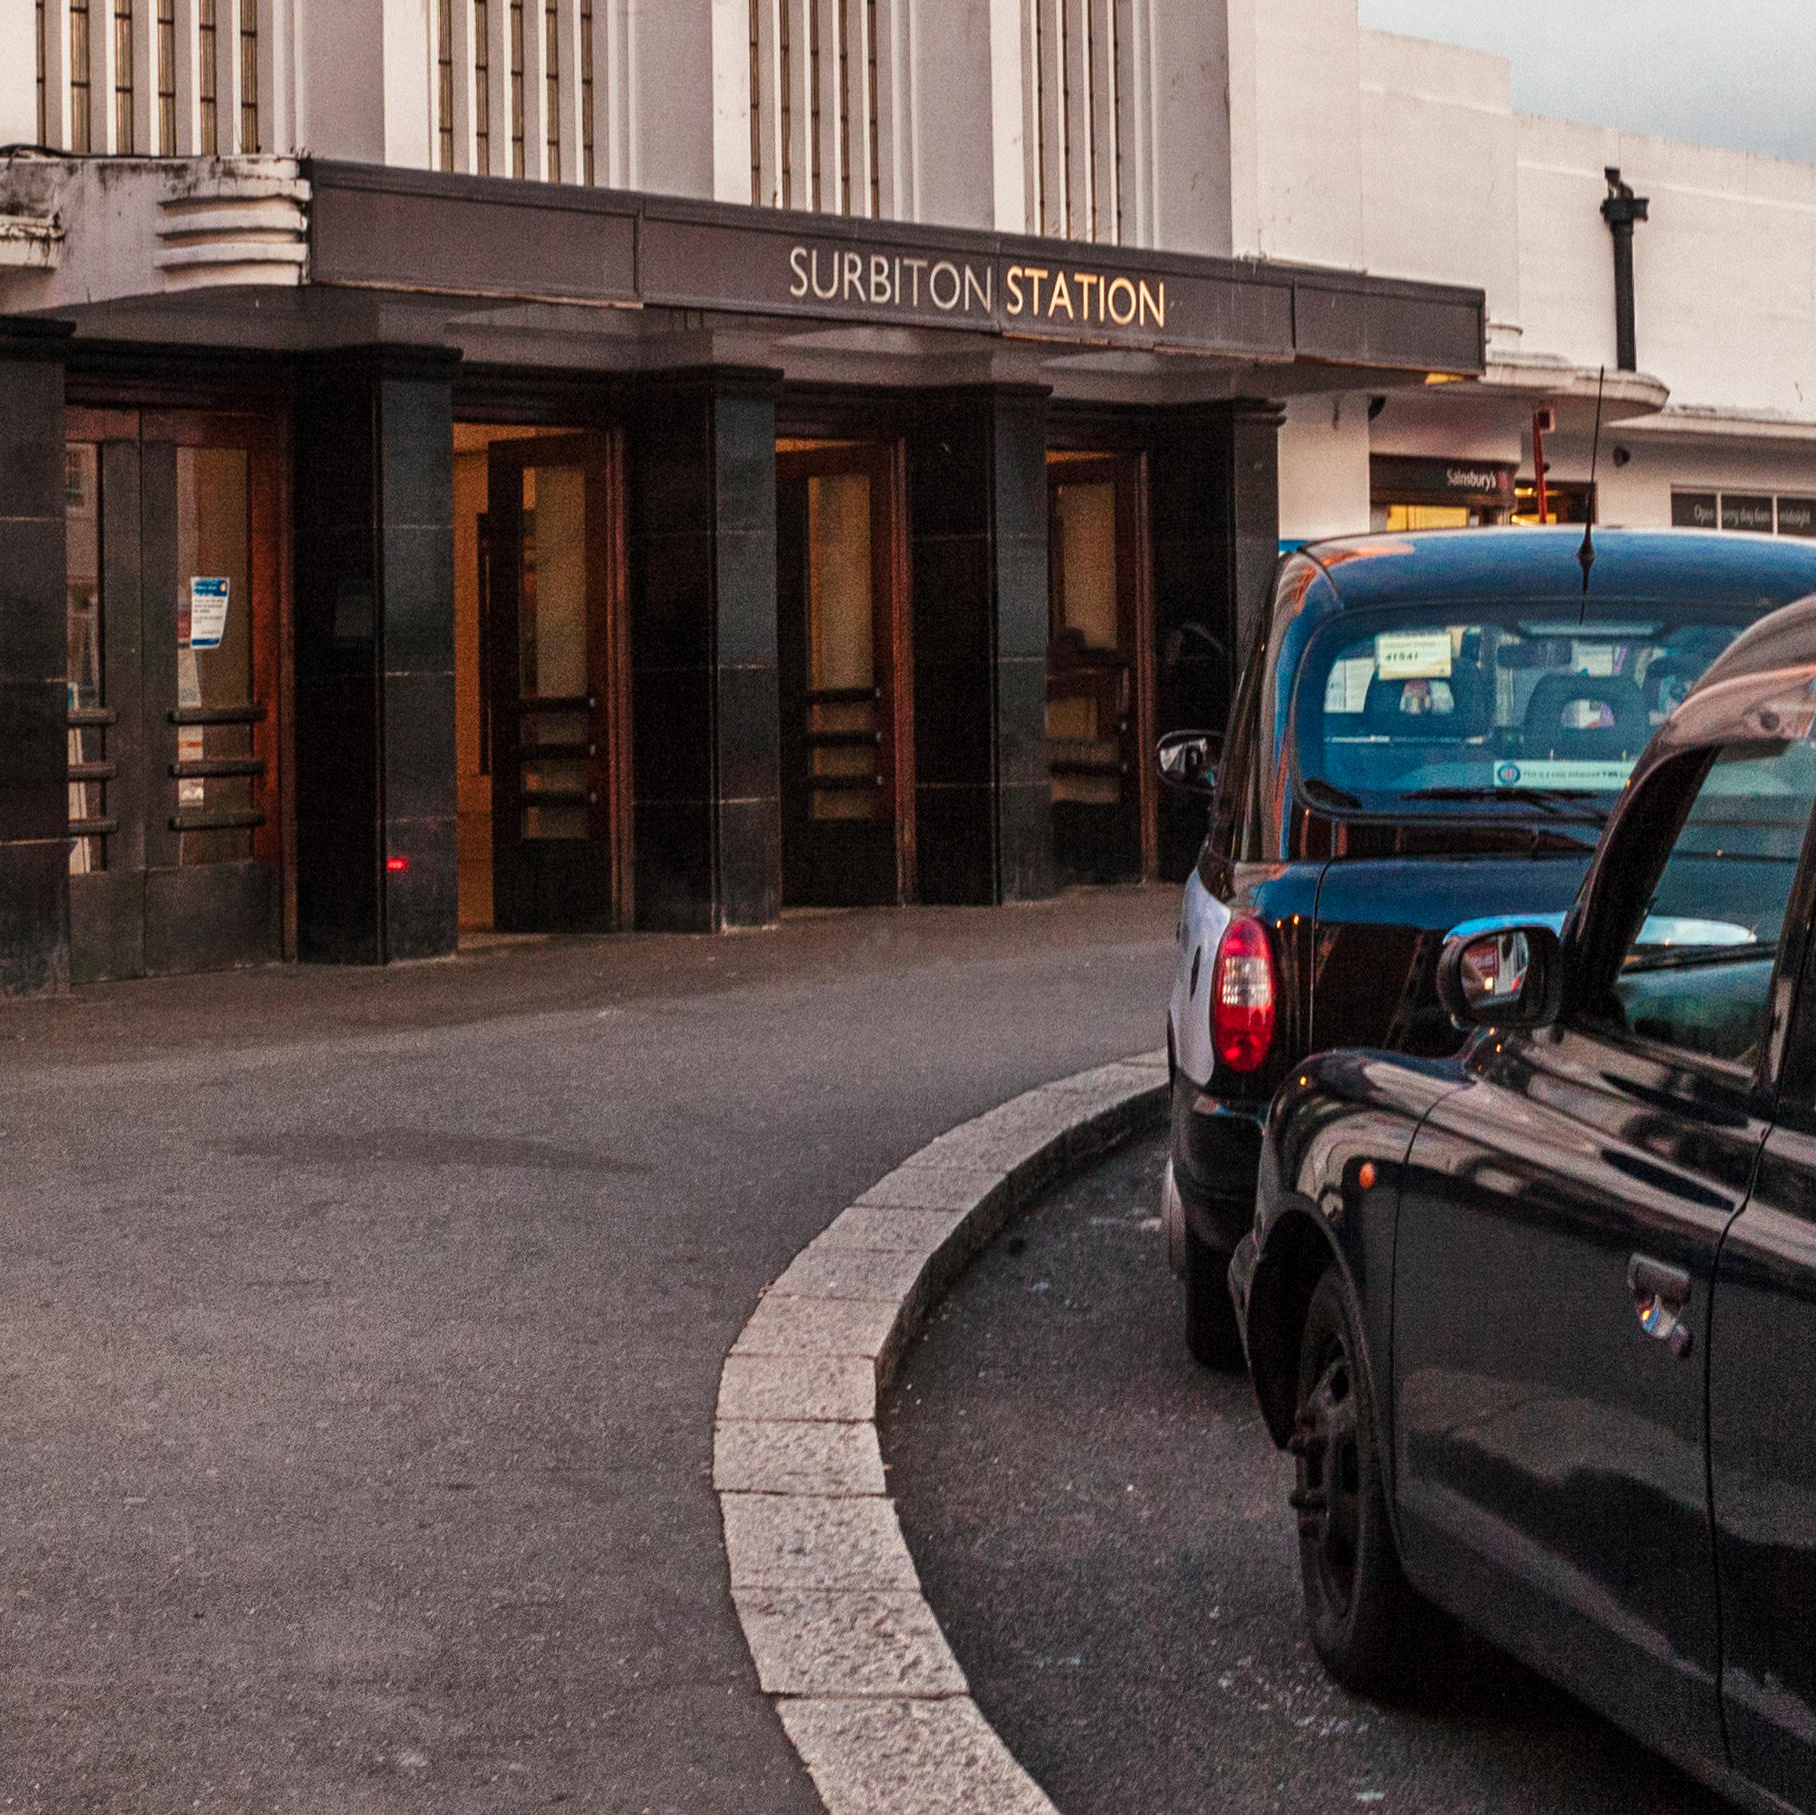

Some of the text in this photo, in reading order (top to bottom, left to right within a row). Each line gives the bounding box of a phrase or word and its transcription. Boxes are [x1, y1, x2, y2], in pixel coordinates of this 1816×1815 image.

[789, 246, 1166, 329] SURBITON STATION
[1446, 468, 1497, 492] Sainsbury's
